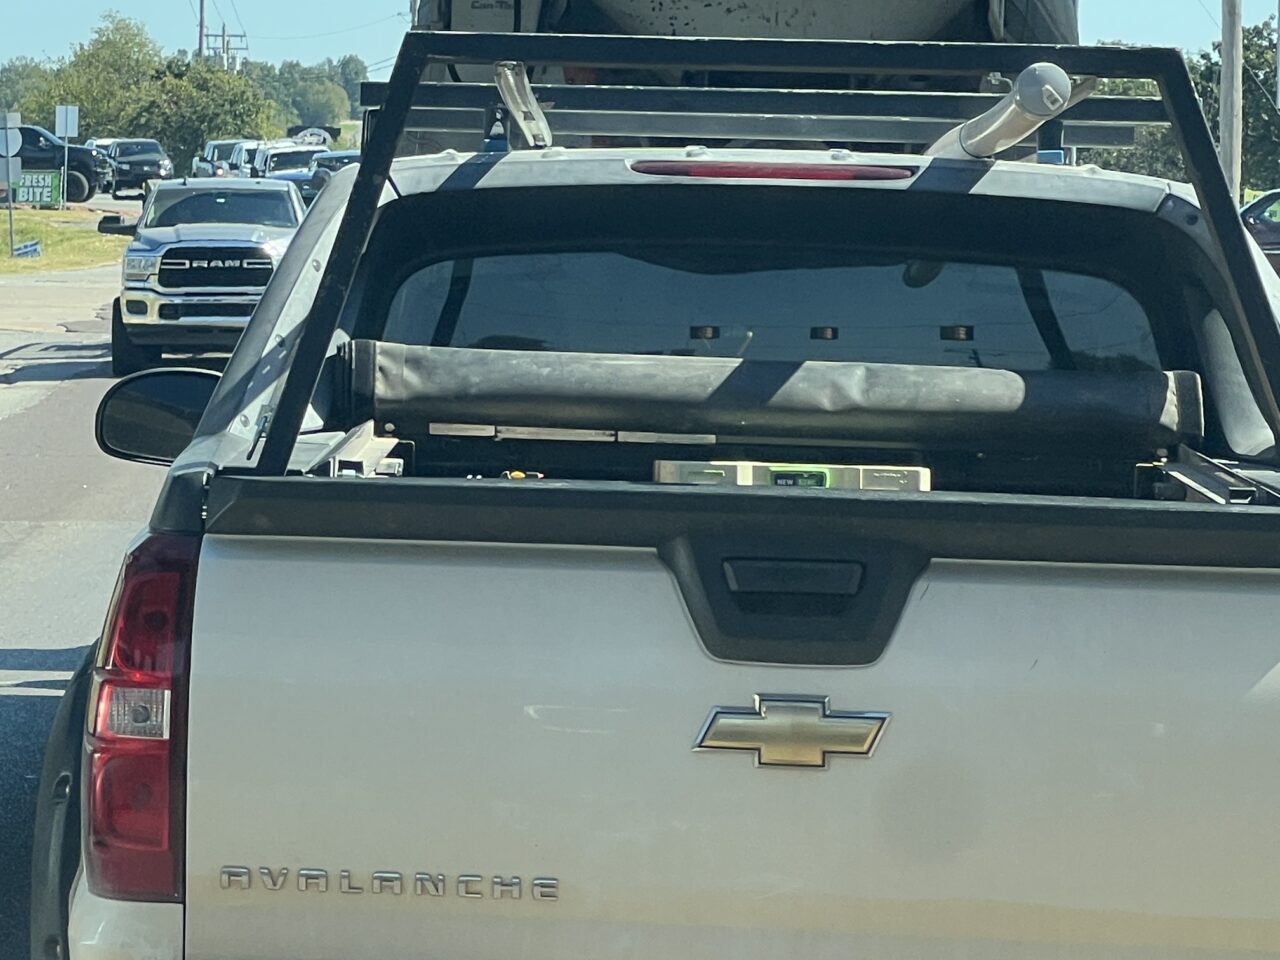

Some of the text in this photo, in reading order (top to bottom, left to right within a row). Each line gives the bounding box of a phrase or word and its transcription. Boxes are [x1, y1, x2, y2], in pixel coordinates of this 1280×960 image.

[20, 174, 52, 187] FRESH
[21, 187, 52, 202] BITE
[192, 259, 241, 268] RAM
[220, 865, 560, 901] AVALANCHE
